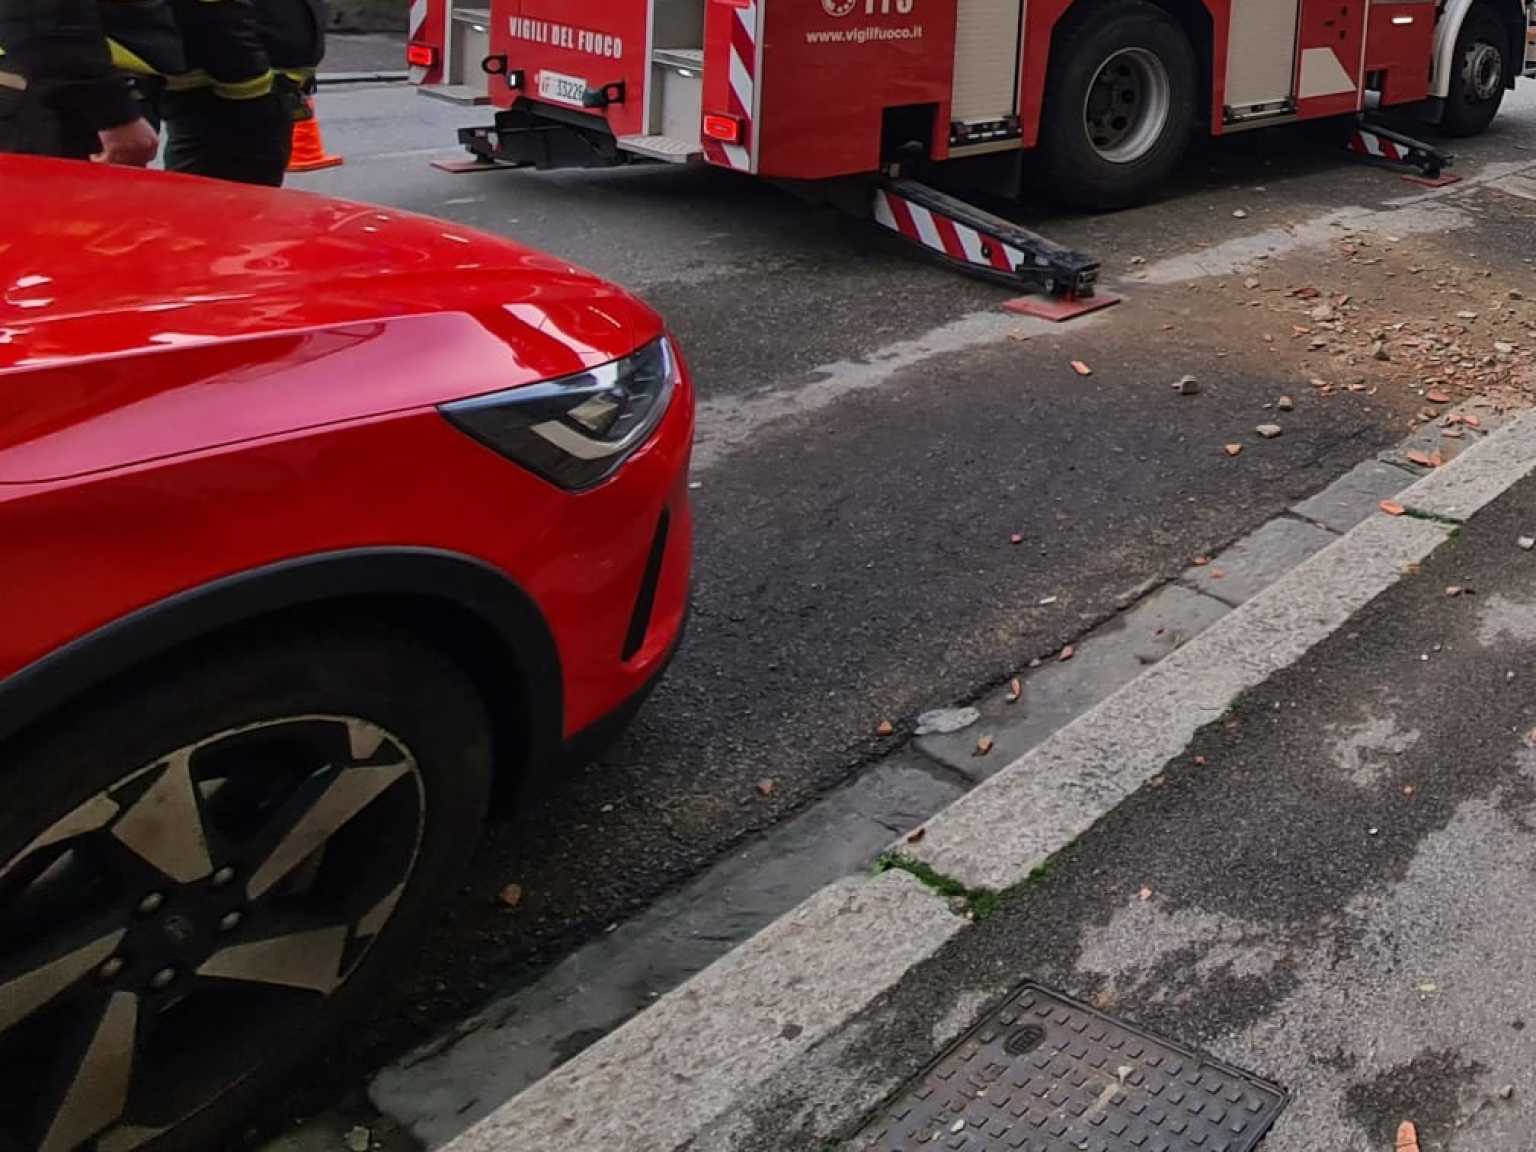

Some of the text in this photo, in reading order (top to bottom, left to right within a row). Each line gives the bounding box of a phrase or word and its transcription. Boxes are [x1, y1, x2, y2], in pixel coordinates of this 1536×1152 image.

[509, 16, 623, 59] VIGILI DEL FUOCO
